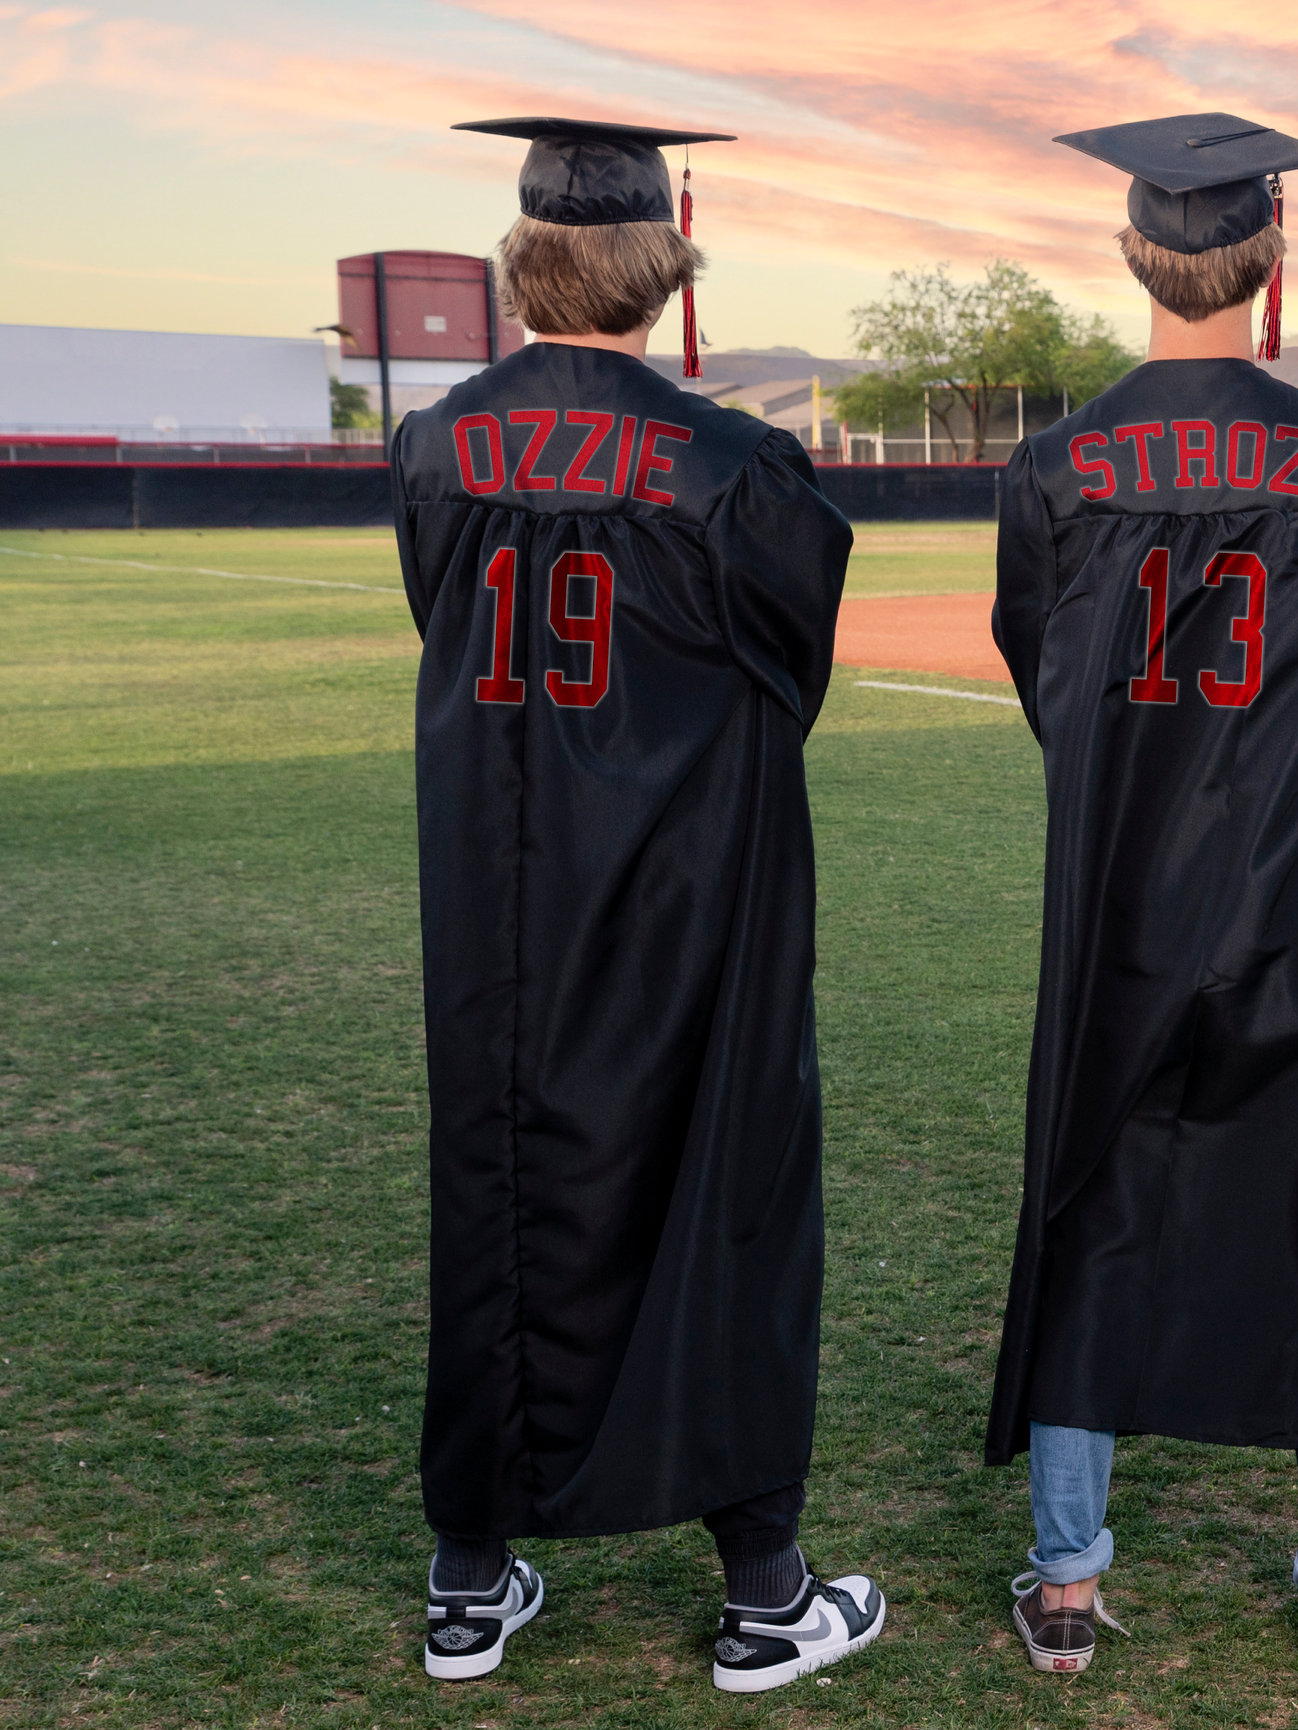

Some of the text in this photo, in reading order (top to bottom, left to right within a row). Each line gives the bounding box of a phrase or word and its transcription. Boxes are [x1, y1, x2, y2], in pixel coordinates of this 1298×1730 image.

[452, 408, 693, 507] OZZIE
[475, 547, 615, 708] 19
[1129, 547, 1268, 708] 13
